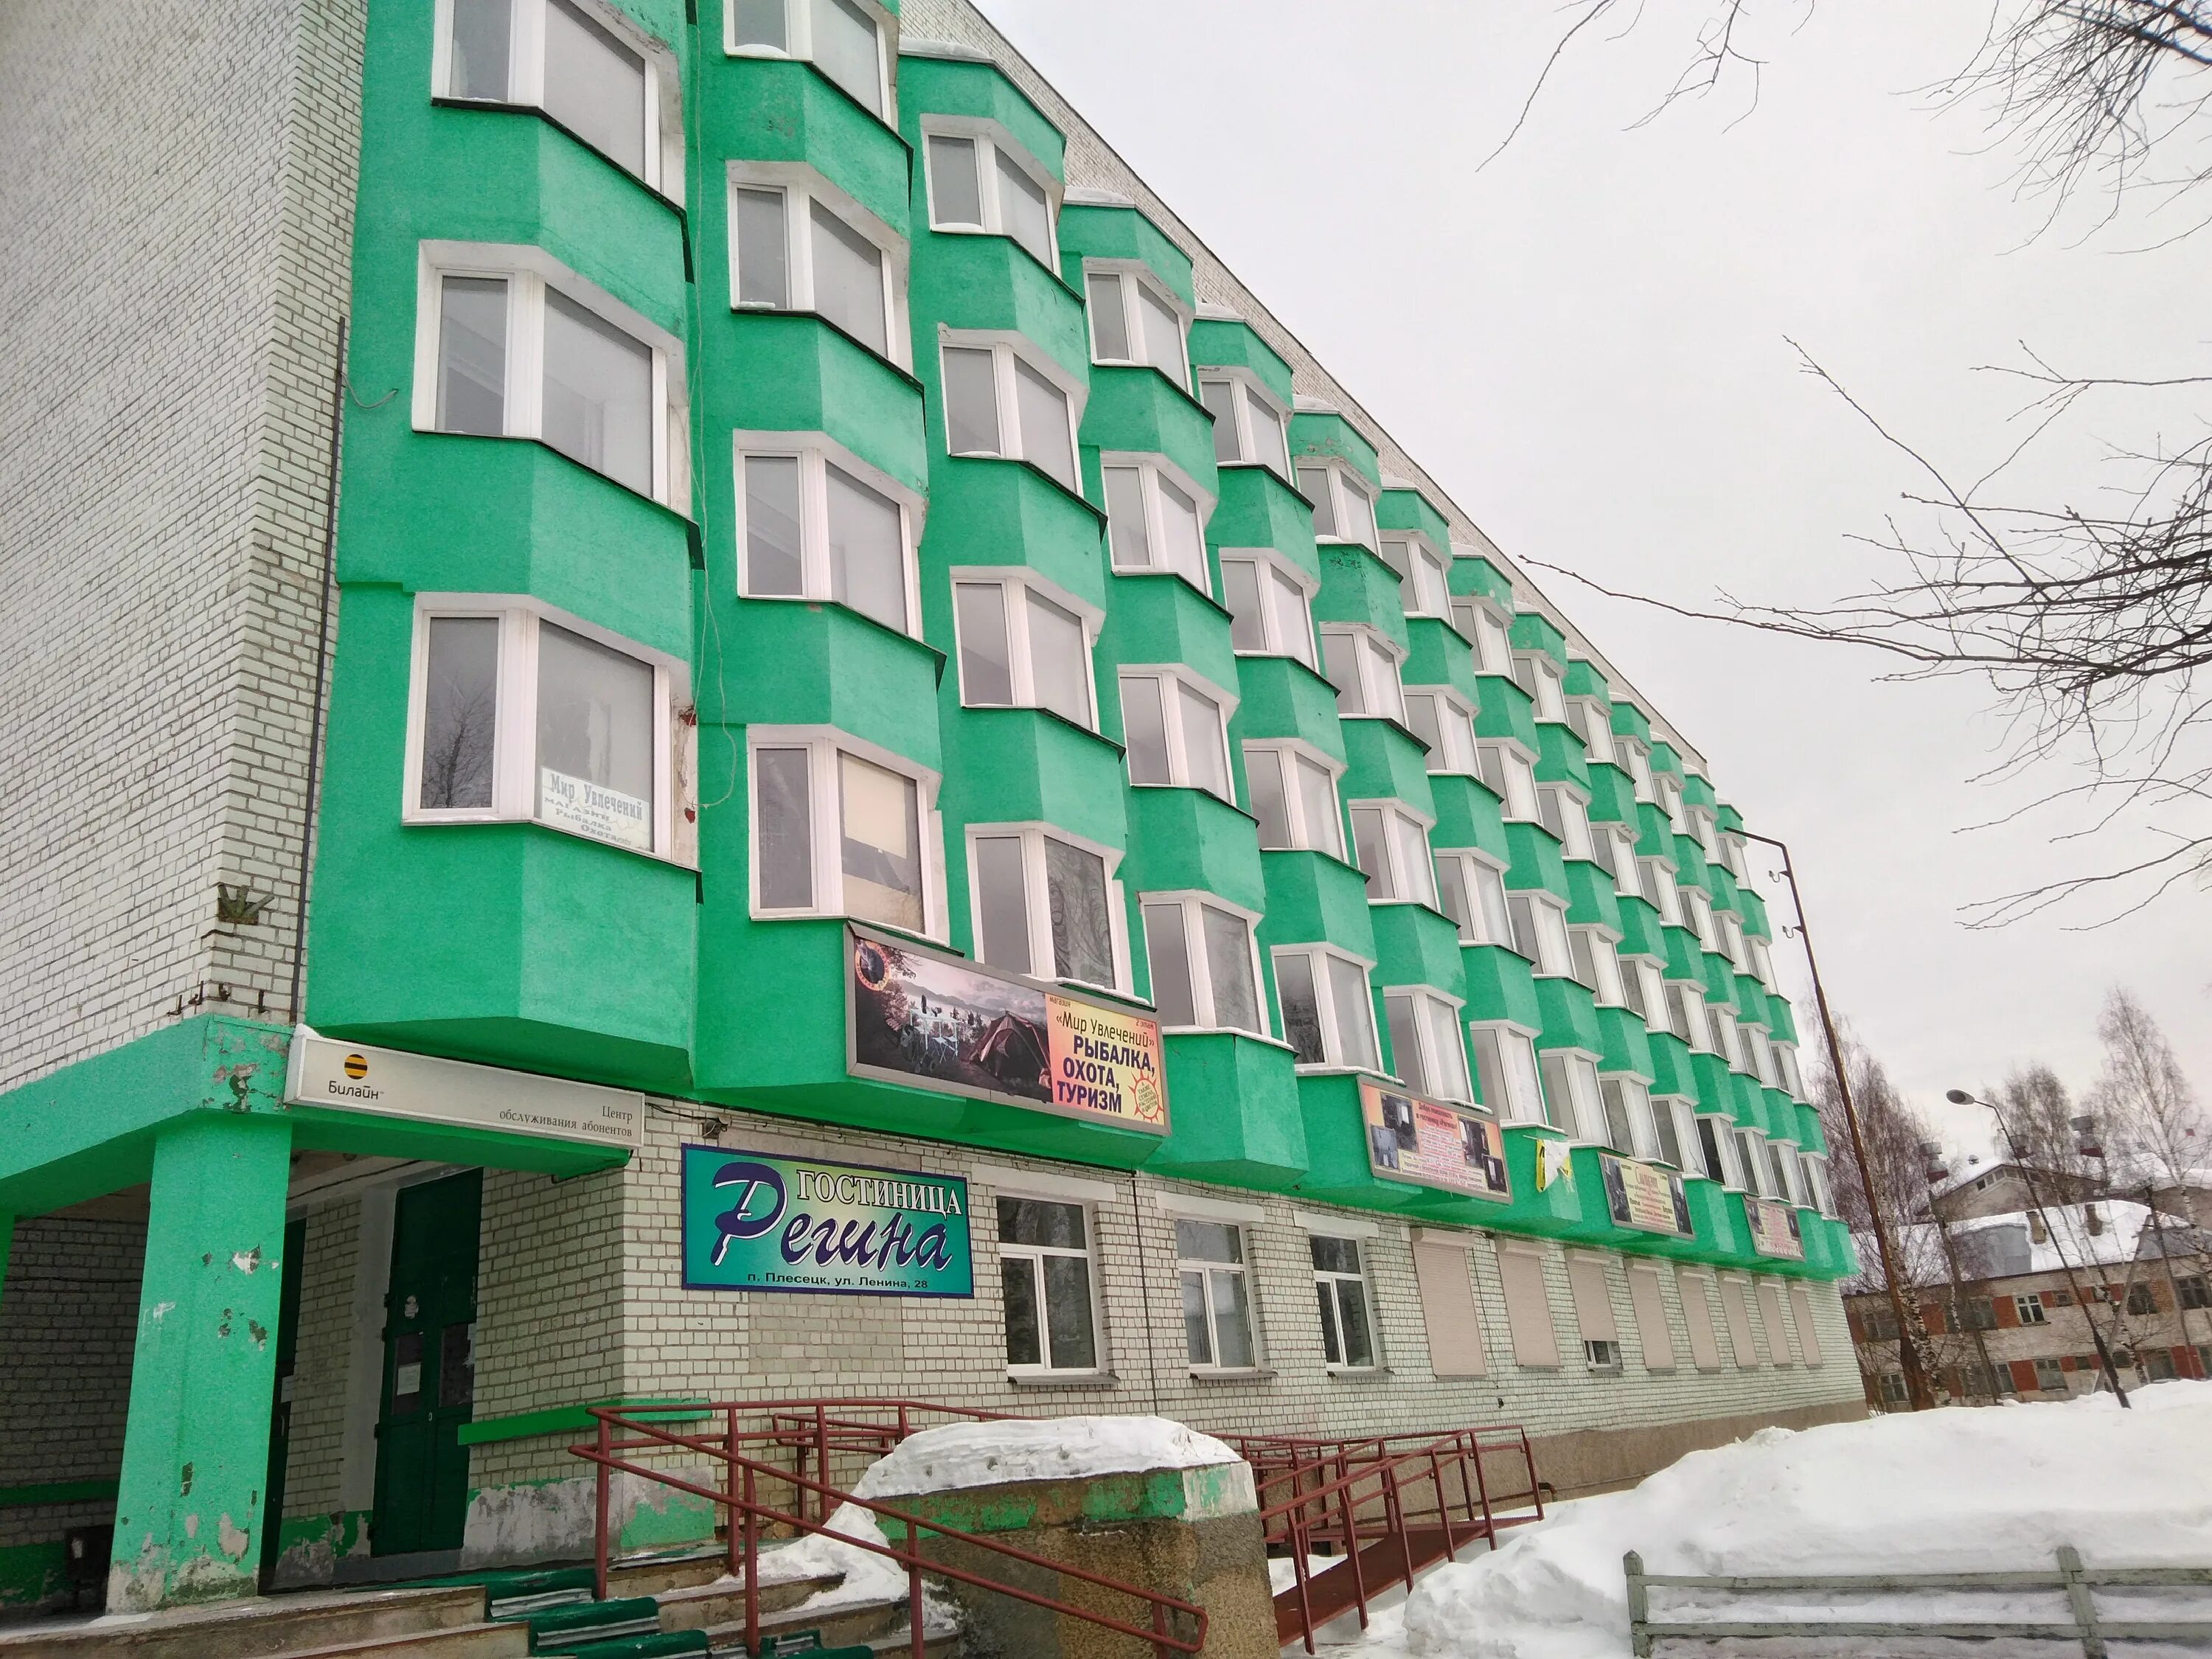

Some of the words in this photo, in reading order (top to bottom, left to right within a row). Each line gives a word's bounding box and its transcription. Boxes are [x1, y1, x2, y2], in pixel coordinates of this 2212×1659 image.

[551, 773, 575, 802] Мир
[584, 784, 643, 820] Увлечений
[555, 807, 612, 831] Рыбалка
[1049, 996, 1071, 1008] магазин
[1056, 1011, 1087, 1034] «Мир
[1091, 1018, 1155, 1048] Увлечений»
[1074, 1034, 1155, 1077] РЫБАЛКА,
[328, 1080, 378, 1099] Билайн
[1063, 1057, 1119, 1093] ОХОТА,
[1057, 1081, 1121, 1113] ТУРИЗМ
[499, 1109, 577, 1129] обслуживания
[582, 1121, 633, 1137] абонентов
[602, 1105, 633, 1124] Центр
[796, 1169, 962, 1220] ГОСТИНИЦА
[710, 1161, 953, 1272] Регина
[747, 1273, 761, 1283] п.
[765, 1272, 830, 1287] Плесецк,
[834, 1276, 855, 1287] ул.
[858, 1276, 911, 1290] Ленина,
[914, 1279, 928, 1289] 28
